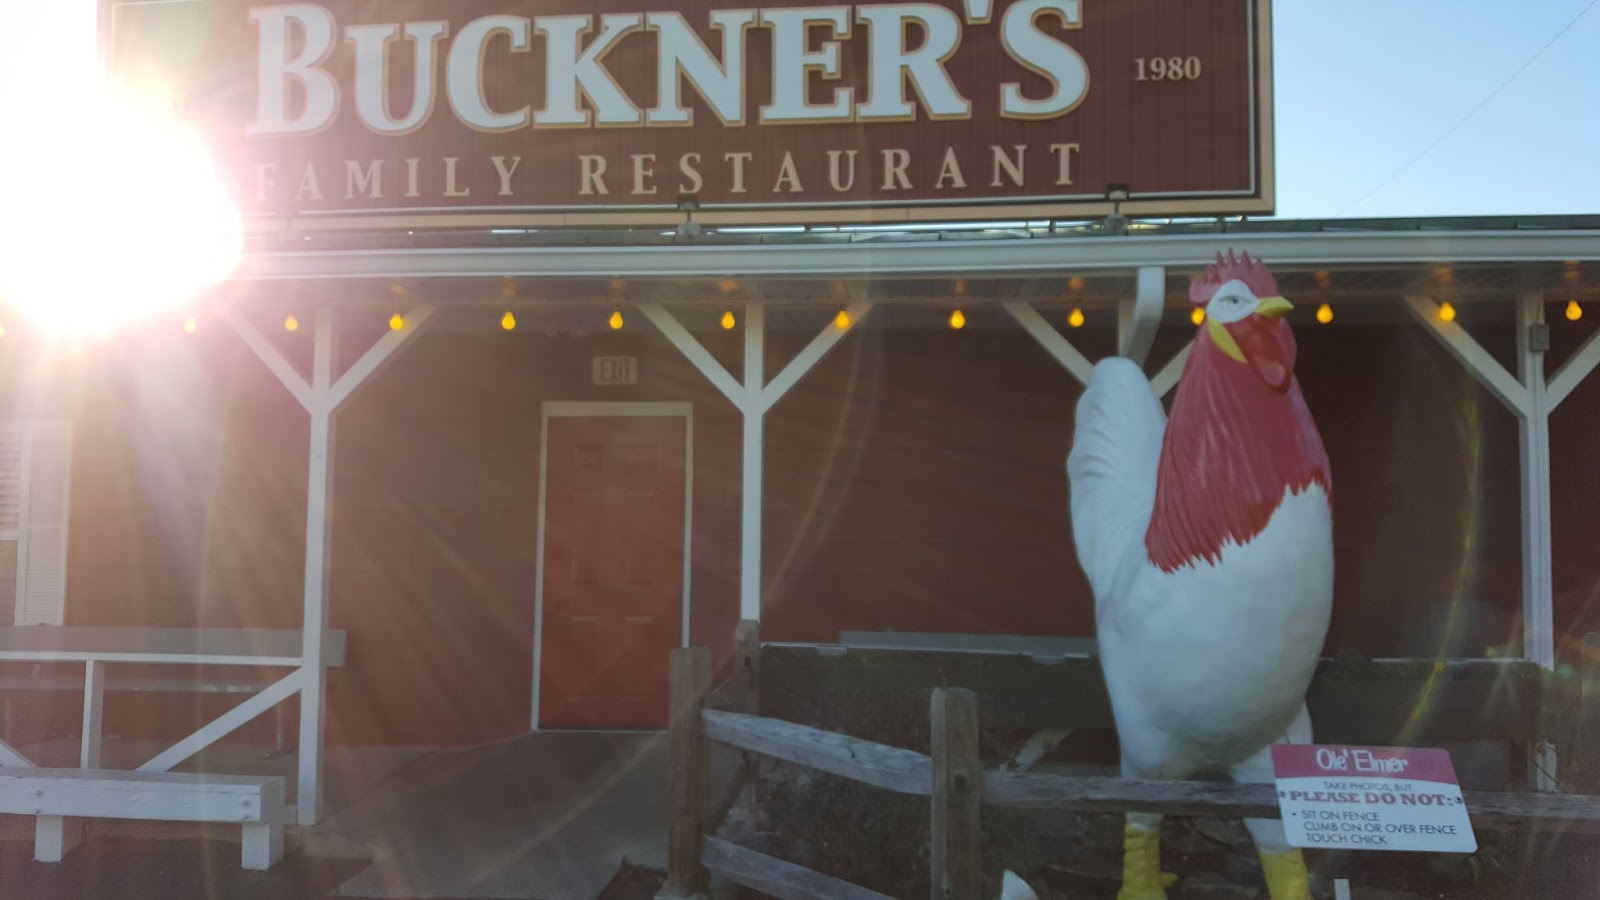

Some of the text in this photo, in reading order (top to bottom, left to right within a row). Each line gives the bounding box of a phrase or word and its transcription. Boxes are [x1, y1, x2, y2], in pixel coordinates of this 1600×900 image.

[246, 0, 1091, 138] BUCKNER'S
[1134, 56, 1202, 82] 1980
[254, 142, 1080, 200] FAMILY RESTAURANT
[600, 359, 630, 381] EXIT
[1353, 750, 1408, 773] Elmer
[1323, 781, 1348, 789] TAKE
[1393, 783, 1412, 791] BUT
[1289, 790, 1361, 804] PLEASE
[1363, 793, 1397, 805] DO
[1302, 810, 1380, 821] SIT ON FENCE
[1303, 821, 1457, 835] CLIMB ON OR OVER FENCE
[1305, 833, 1387, 845] TOUCH CHICK
